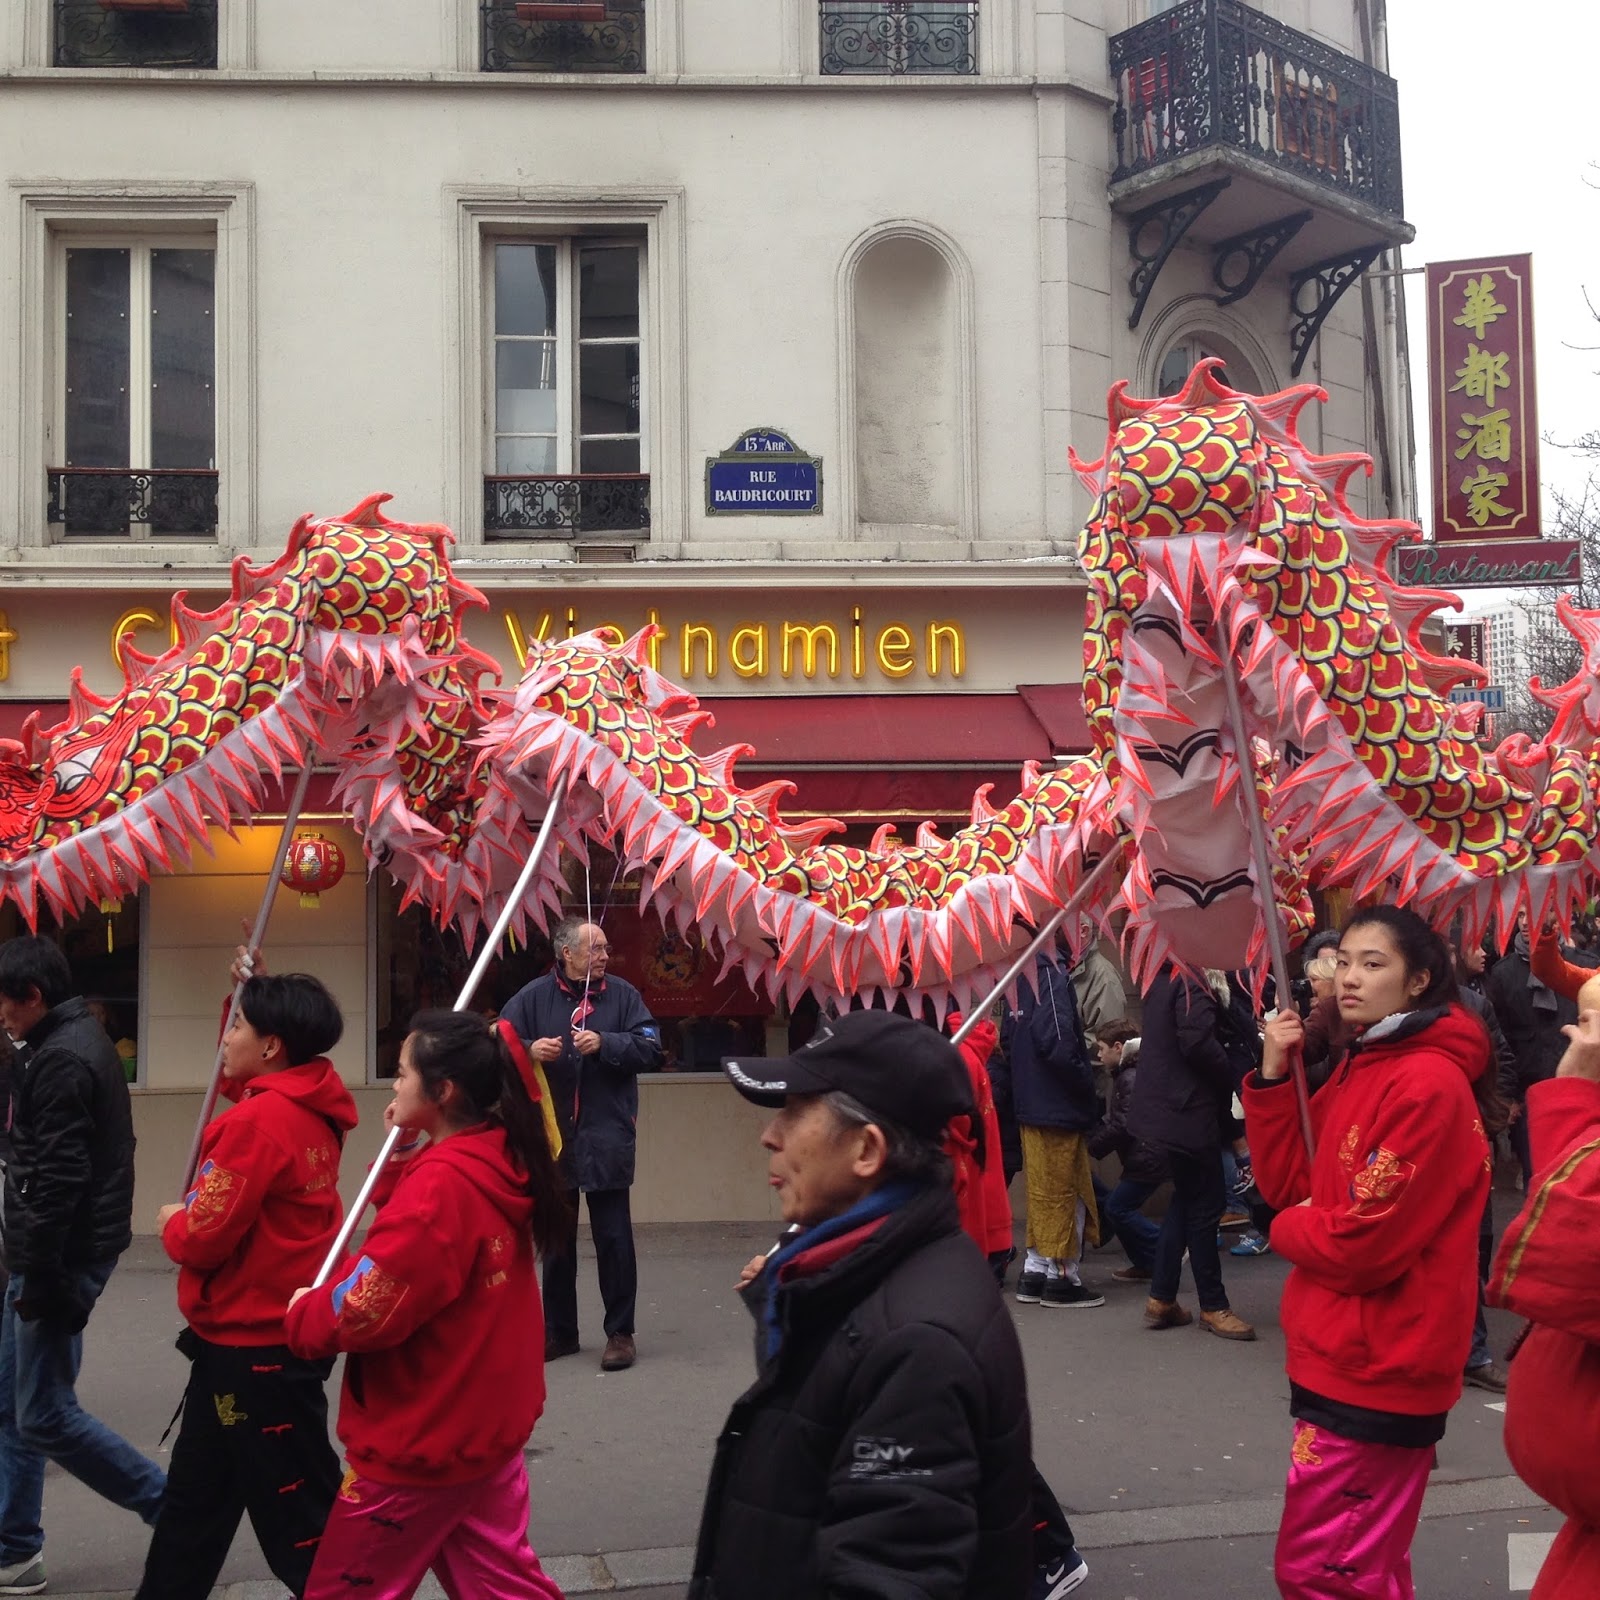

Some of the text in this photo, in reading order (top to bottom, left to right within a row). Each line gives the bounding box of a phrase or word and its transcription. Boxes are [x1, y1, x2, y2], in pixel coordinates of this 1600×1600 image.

[1448, 272, 1515, 527] 華都酒家
[749, 470, 777, 483] RUE
[714, 489, 813, 502] BAUDRICOURT
[1398, 547, 1580, 585] Restaurant
